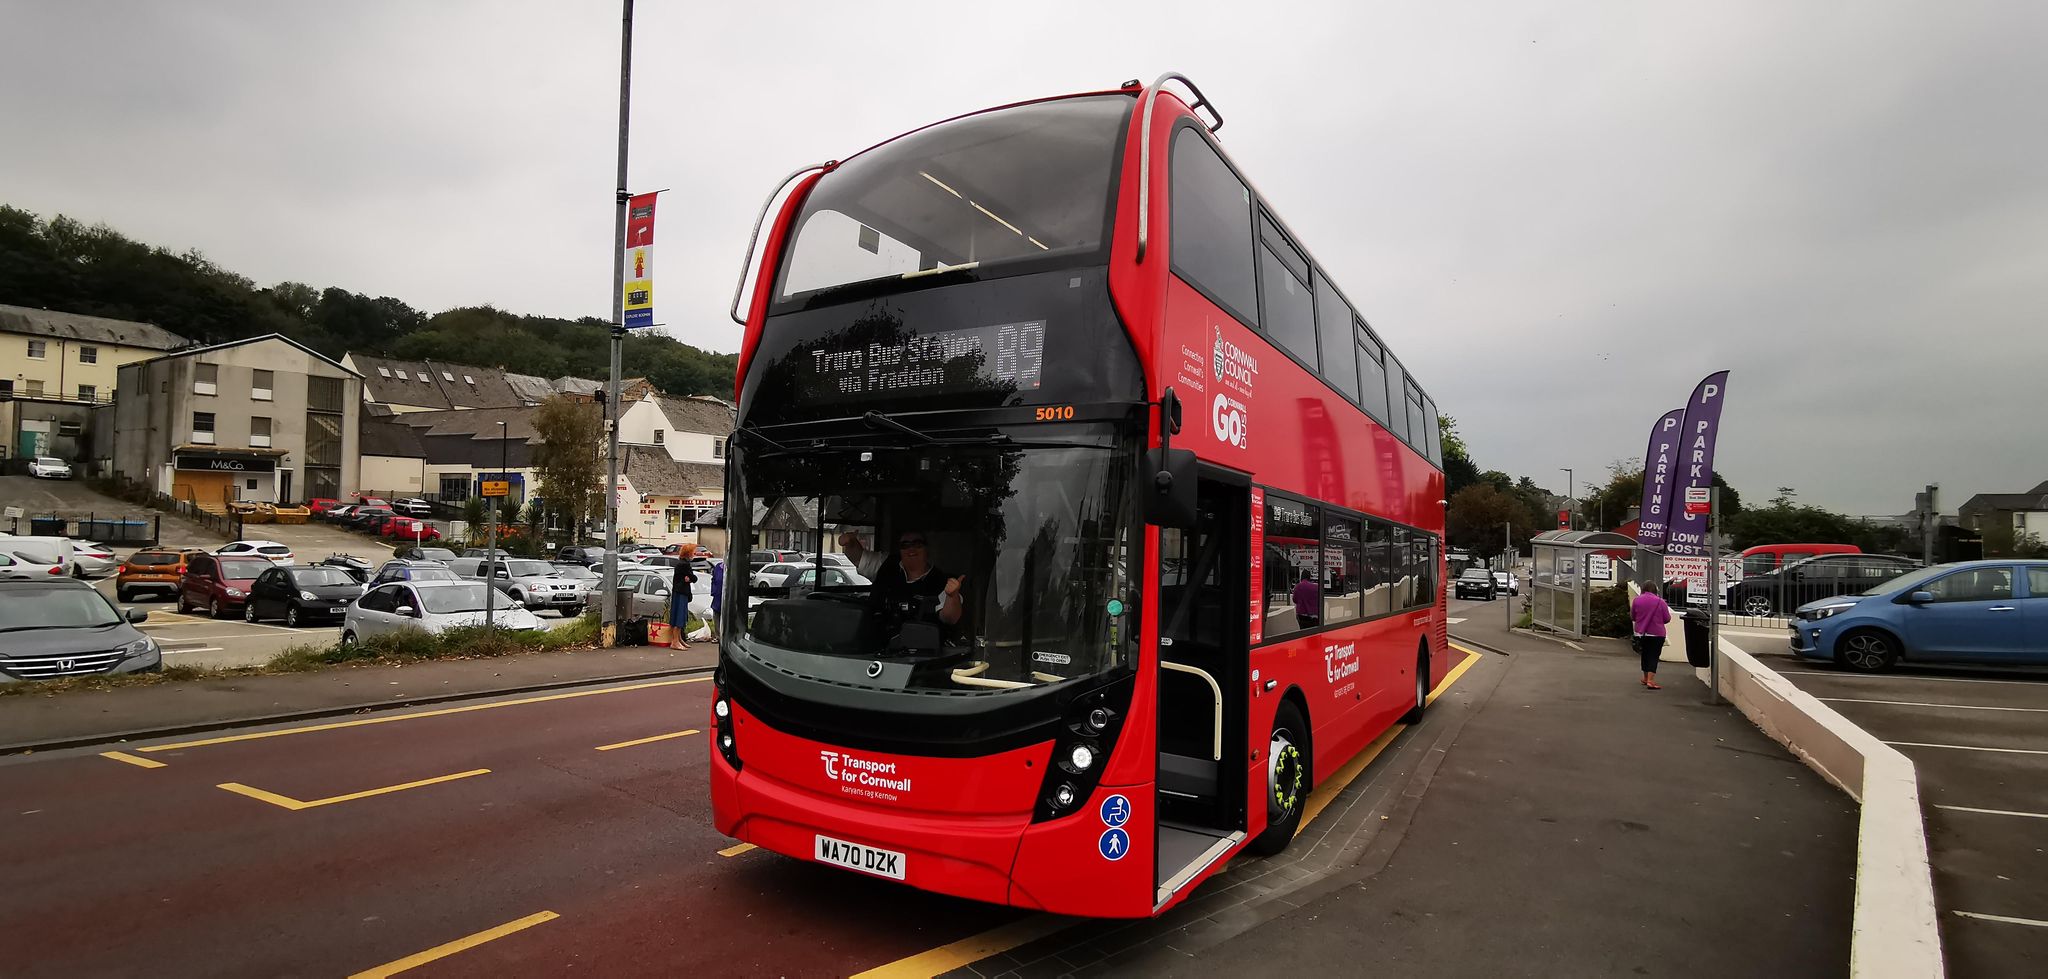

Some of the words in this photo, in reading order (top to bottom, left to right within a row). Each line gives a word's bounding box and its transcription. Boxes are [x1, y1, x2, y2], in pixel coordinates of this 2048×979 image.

[812, 349, 863, 373] Truro
[868, 343, 901, 368] Bus
[907, 332, 981, 363] Station
[997, 322, 1043, 380] 89
[1181, 344, 1205, 367] Connecting
[1224, 341, 1258, 375] CORNWALL
[838, 371, 862, 393] via
[868, 364, 944, 391] Fraddon
[1177, 371, 1204, 393] Communities
[1224, 358, 1253, 388] COUNCIL
[1701, 384, 1718, 404] P
[1036, 406, 1074, 421] 5010
[1212, 393, 1241, 447] GO
[1663, 418, 1677, 432] P
[1650, 443, 1670, 514] PARKING
[1683, 420, 1708, 521] PARKIG
[1638, 529, 1664, 539] COST
[1641, 521, 1663, 530] LOW
[1672, 532, 1699, 544] LOW
[1667, 543, 1702, 556] COST
[1334, 640, 1355, 661] Transport
[1341, 656, 1359, 678] Cornwall
[842, 753, 896, 775] Transport
[841, 769, 857, 783] for
[859, 771, 911, 792] Cornwall
[874, 791, 898, 802] Kernow
[821, 838, 861, 866] WA70
[865, 848, 898, 875] DZK
